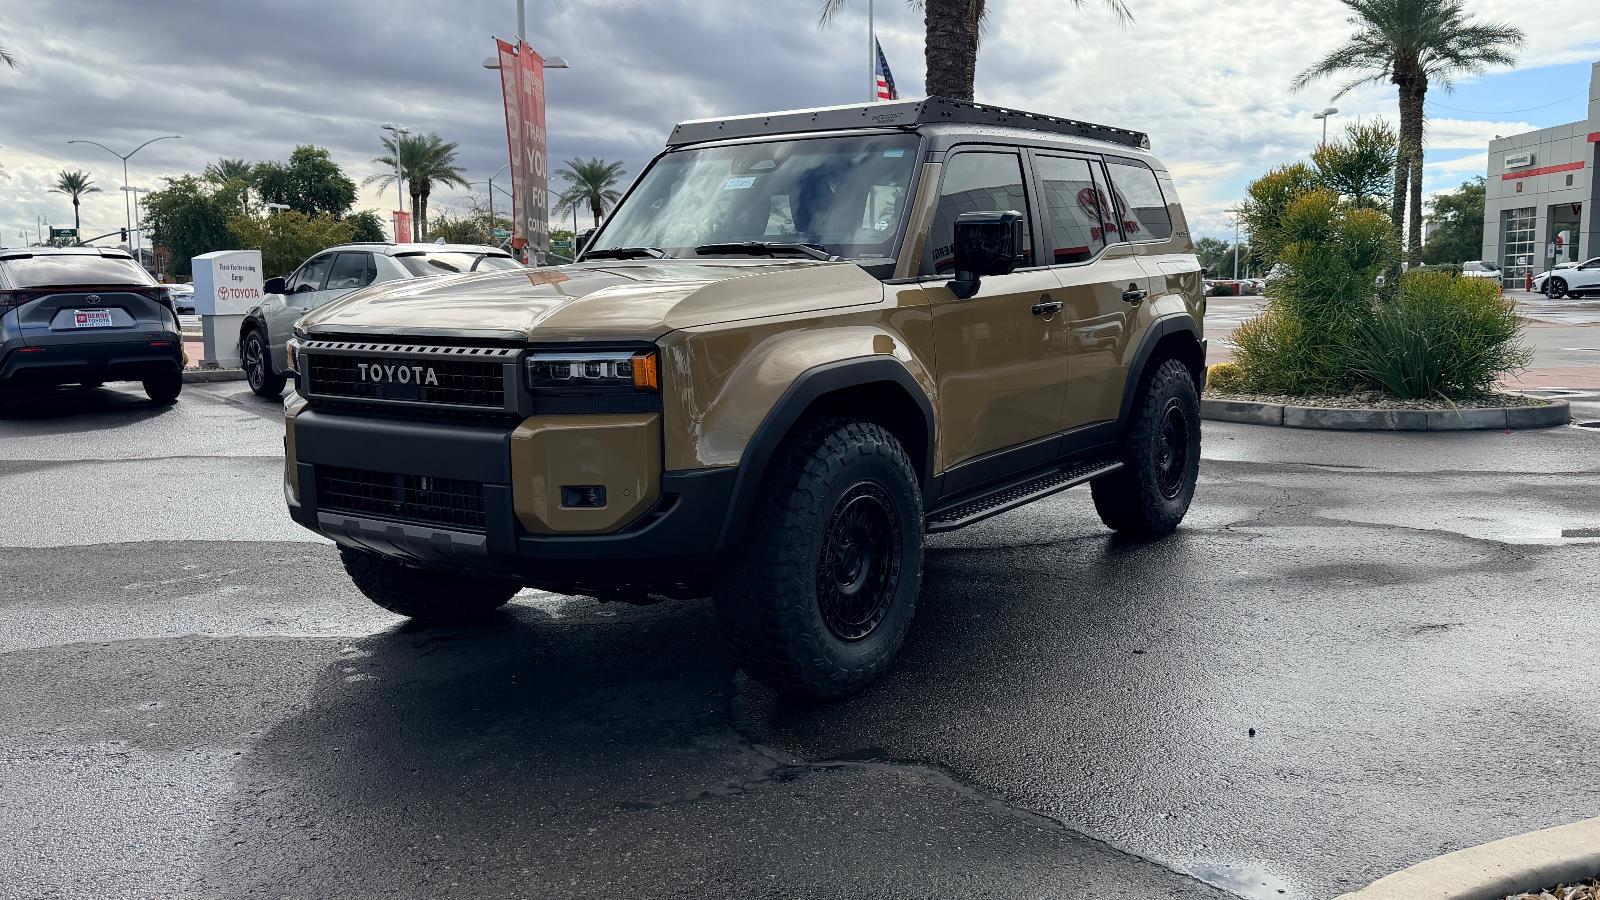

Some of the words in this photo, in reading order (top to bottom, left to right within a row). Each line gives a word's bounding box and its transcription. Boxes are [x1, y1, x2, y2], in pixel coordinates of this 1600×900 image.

[526, 146, 547, 179] YOU
[230, 288, 260, 299] TOYOTA
[357, 363, 439, 386] TOYOTA
